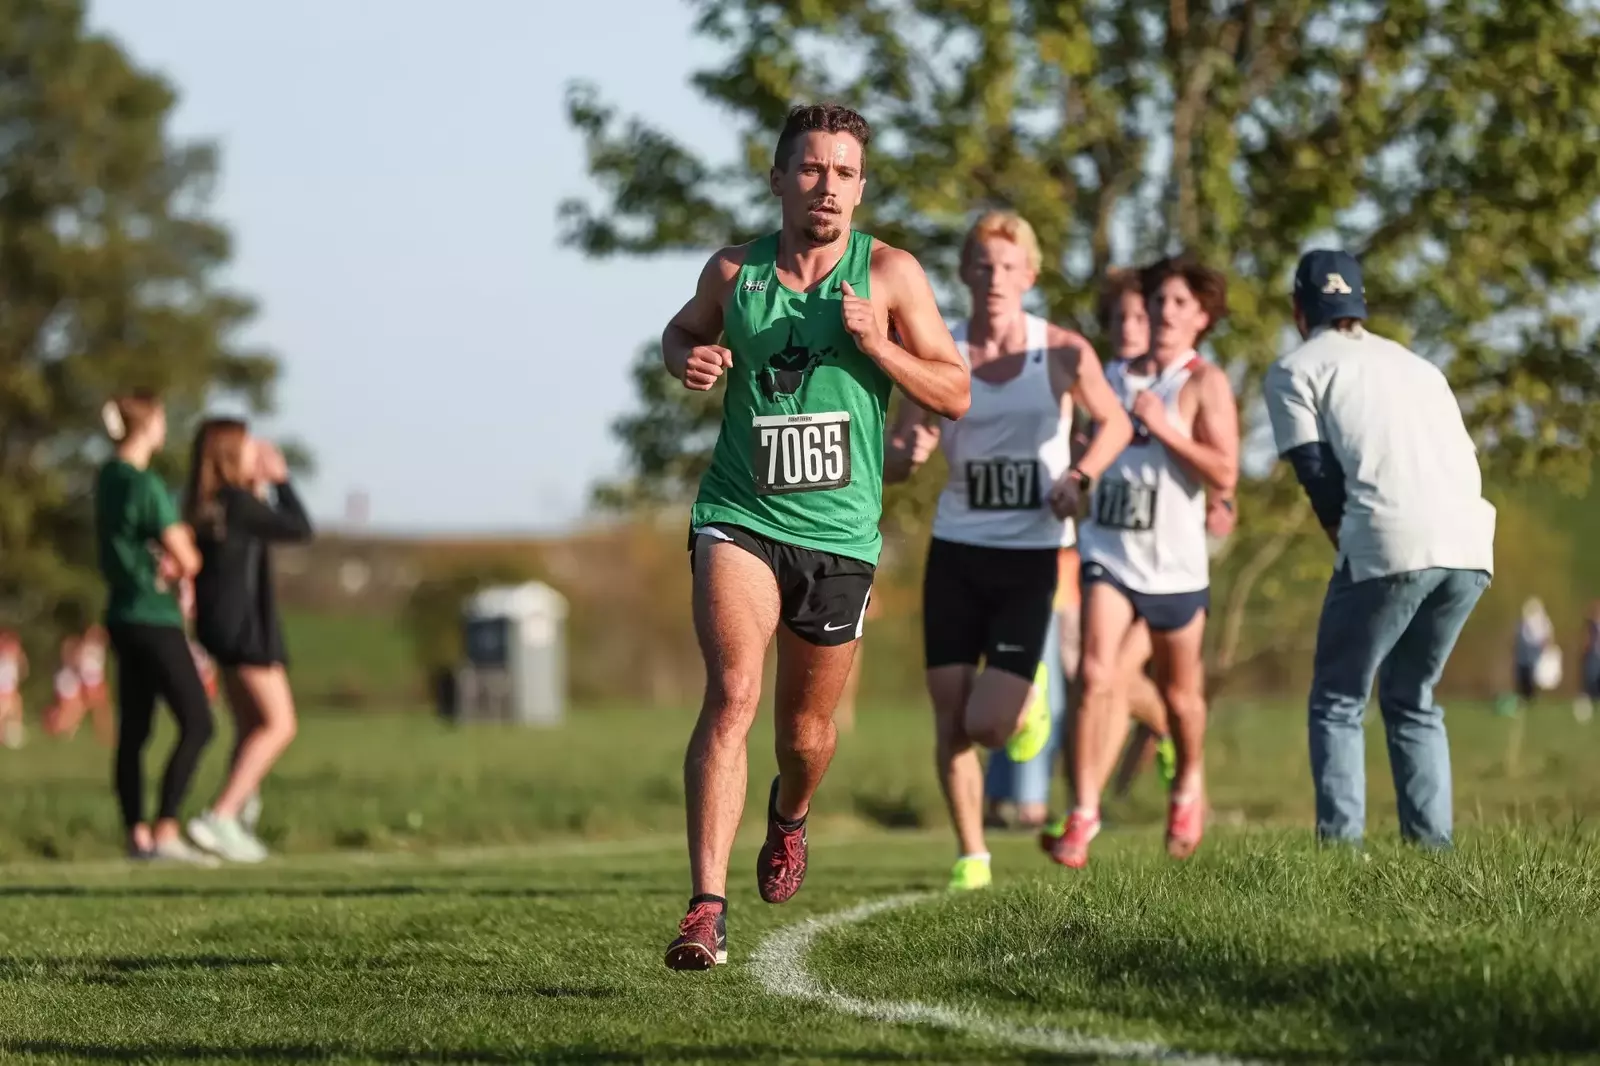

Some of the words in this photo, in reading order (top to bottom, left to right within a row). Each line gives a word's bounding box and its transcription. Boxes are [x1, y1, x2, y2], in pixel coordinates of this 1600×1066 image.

[1322, 272, 1352, 294] A
[761, 424, 844, 485] 7065
[971, 464, 1034, 506] 7197
